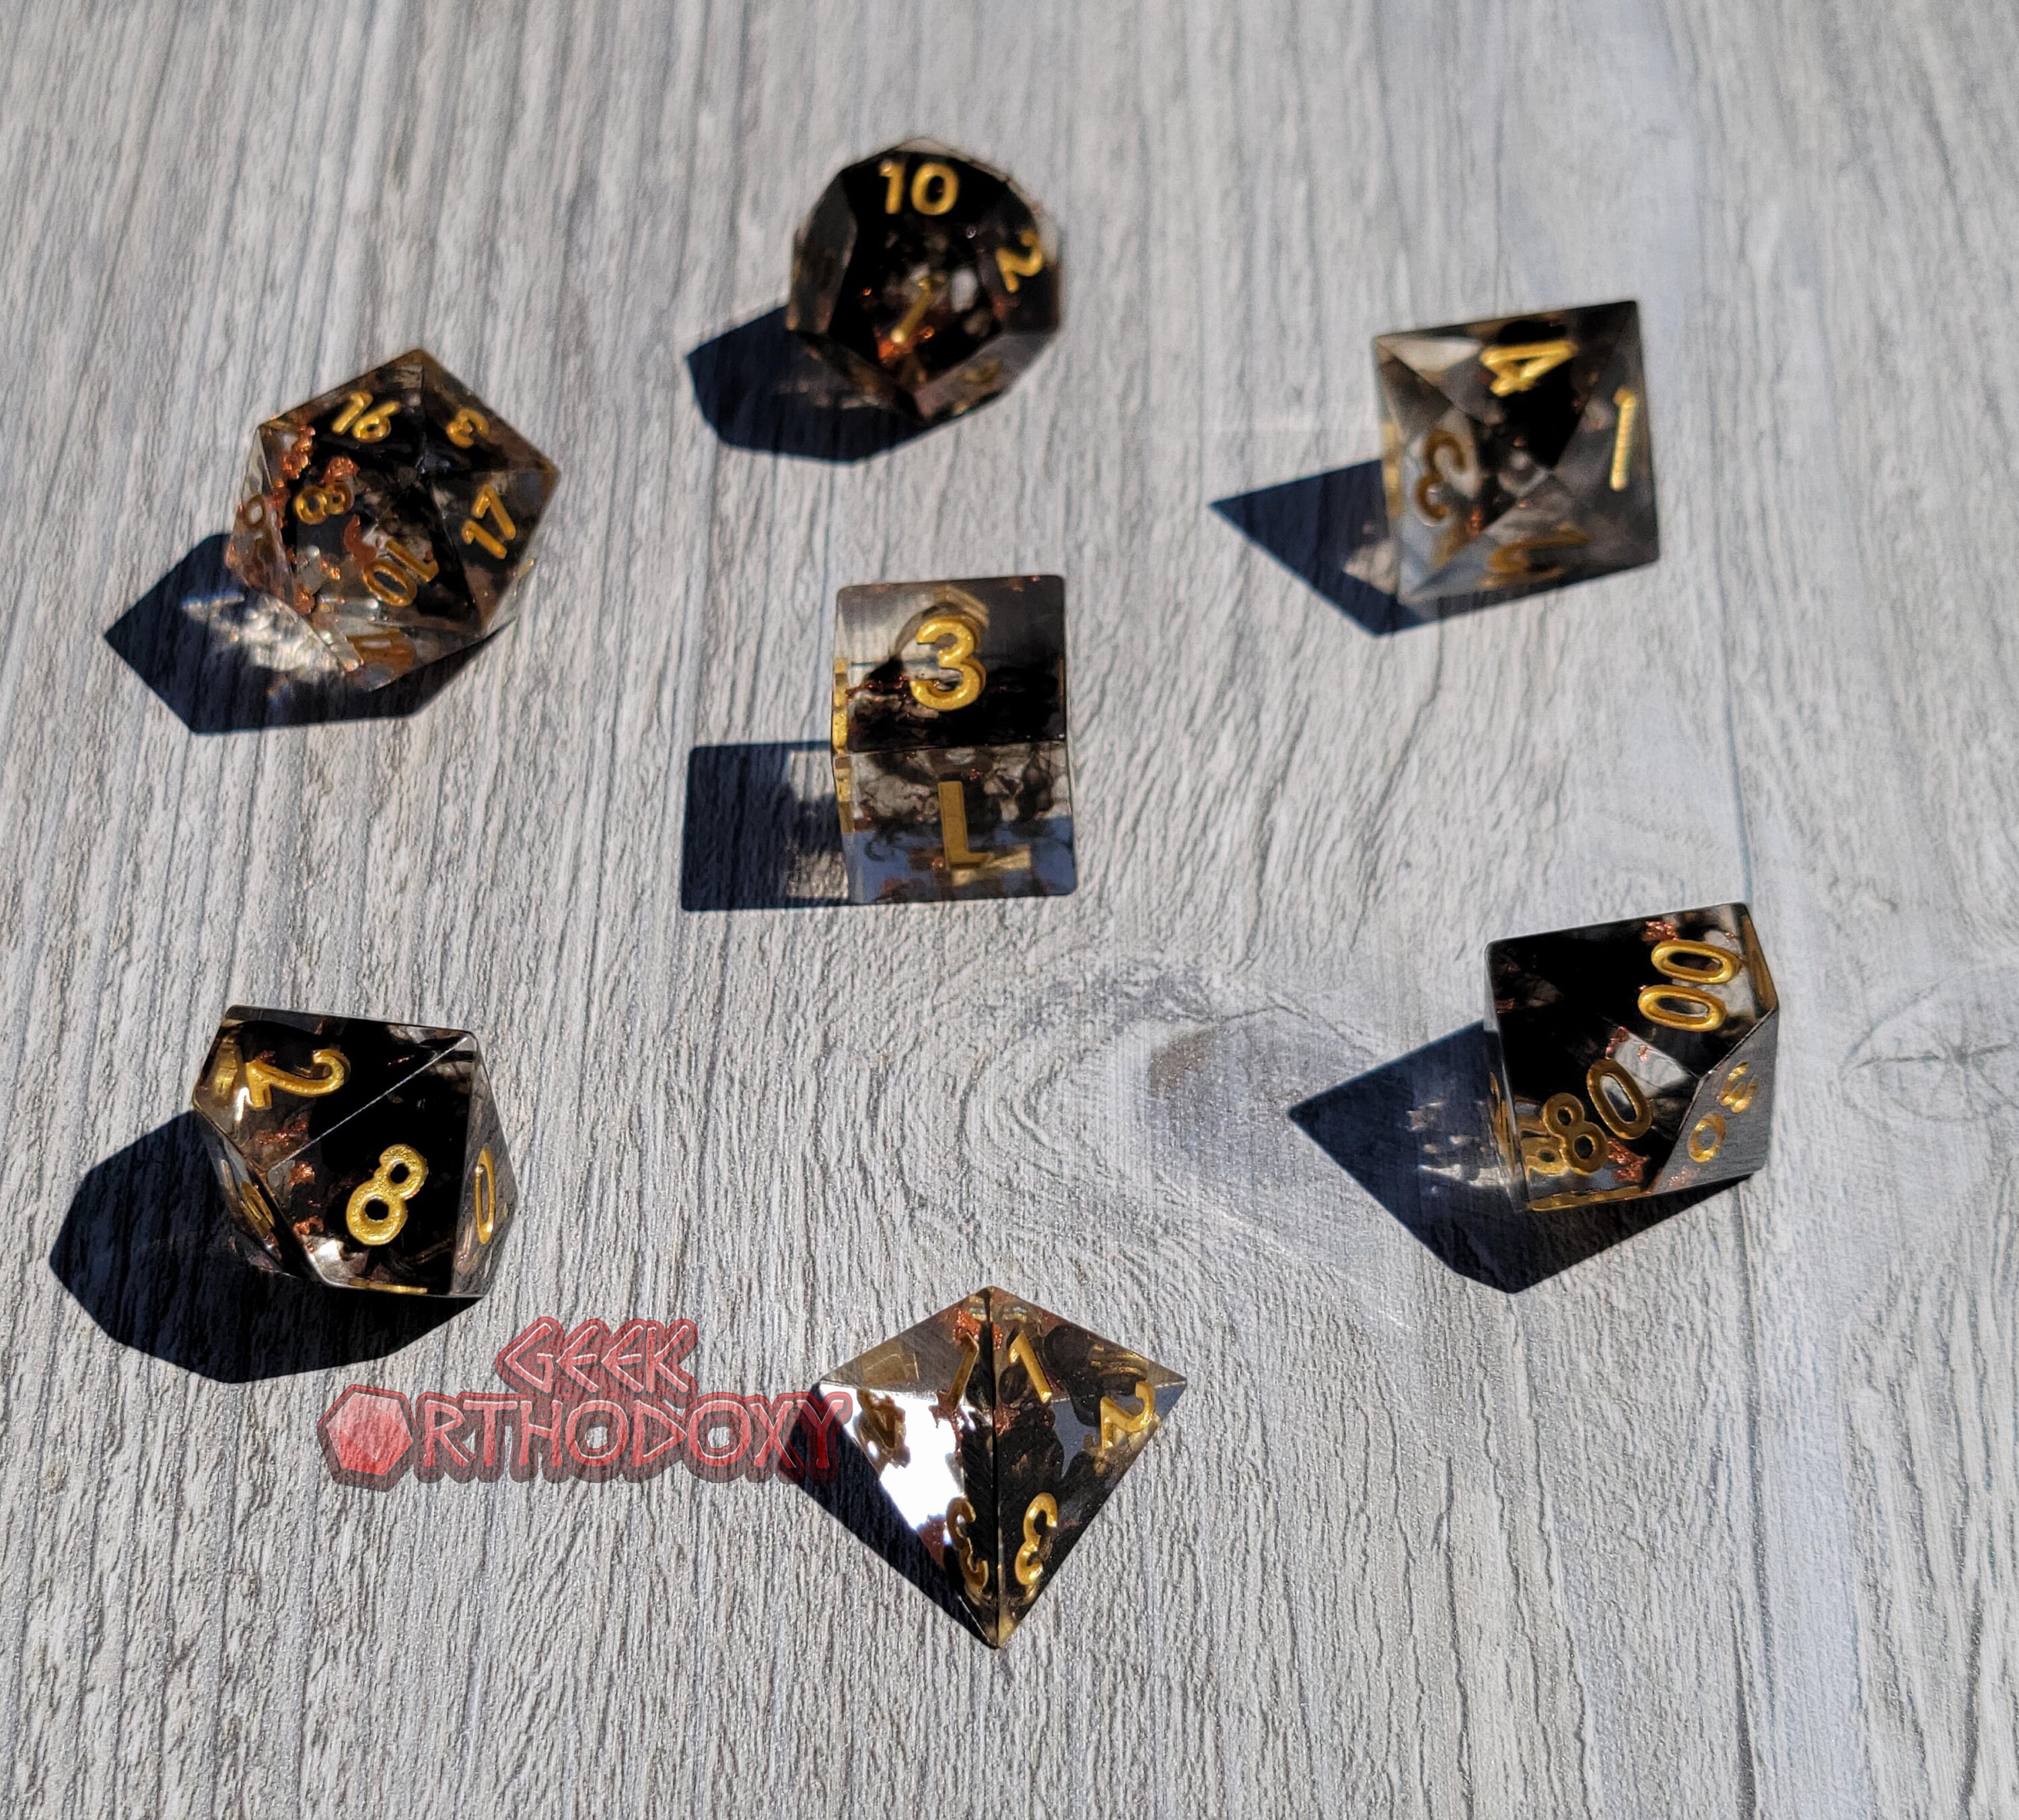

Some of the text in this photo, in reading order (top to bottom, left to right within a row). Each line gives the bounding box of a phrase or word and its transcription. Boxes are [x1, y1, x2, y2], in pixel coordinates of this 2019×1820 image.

[879, 161, 960, 216] 10
[996, 228, 1043, 293] 2
[1481, 338, 1580, 397] 4
[332, 390, 402, 443] 16
[295, 479, 354, 525] 8
[1416, 429, 1466, 527] 3
[461, 483, 517, 560] 17
[363, 538, 440, 608] 10
[909, 614, 986, 713] 3
[1637, 939, 1742, 1033] 00
[246, 1048, 351, 1110] 2
[1543, 1058, 1653, 1176] 80
[346, 1143, 429, 1246] 8
[1010, 1330, 1053, 1404] 1
[1099, 1379, 1157, 1450] 2
[1014, 1492, 1059, 1587] 3
